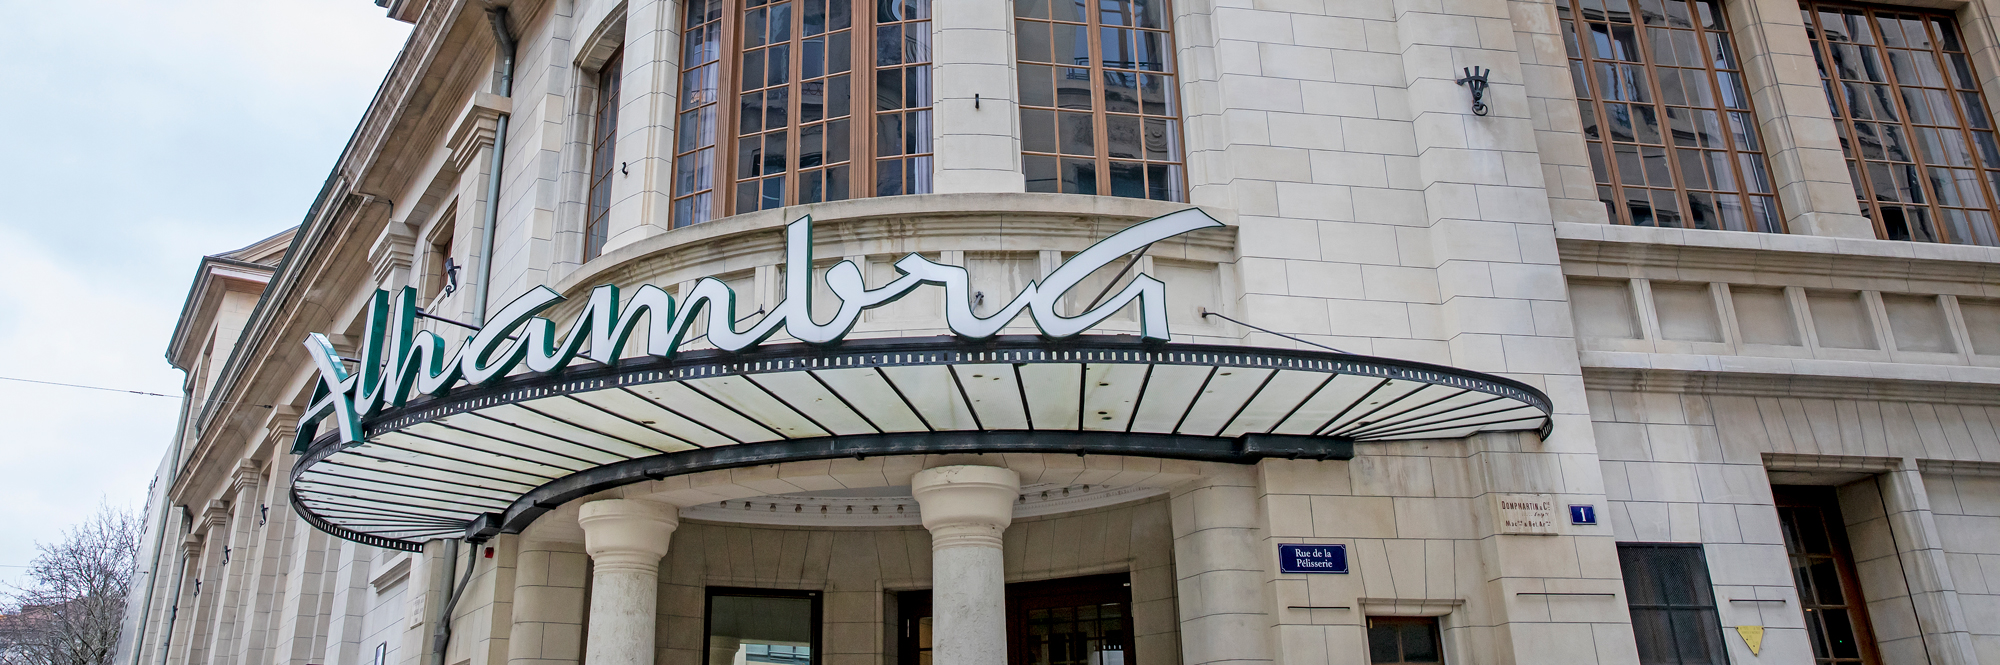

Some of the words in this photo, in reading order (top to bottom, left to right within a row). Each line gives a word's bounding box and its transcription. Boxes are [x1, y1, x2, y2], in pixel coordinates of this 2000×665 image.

[290, 207, 1226, 454] Alhambra
[1580, 507, 1587, 522] 1
[1295, 548, 1311, 558] Rue
[1312, 548, 1322, 558] de
[1323, 548, 1332, 558] la
[1296, 558, 1333, 568] Pélisserie
